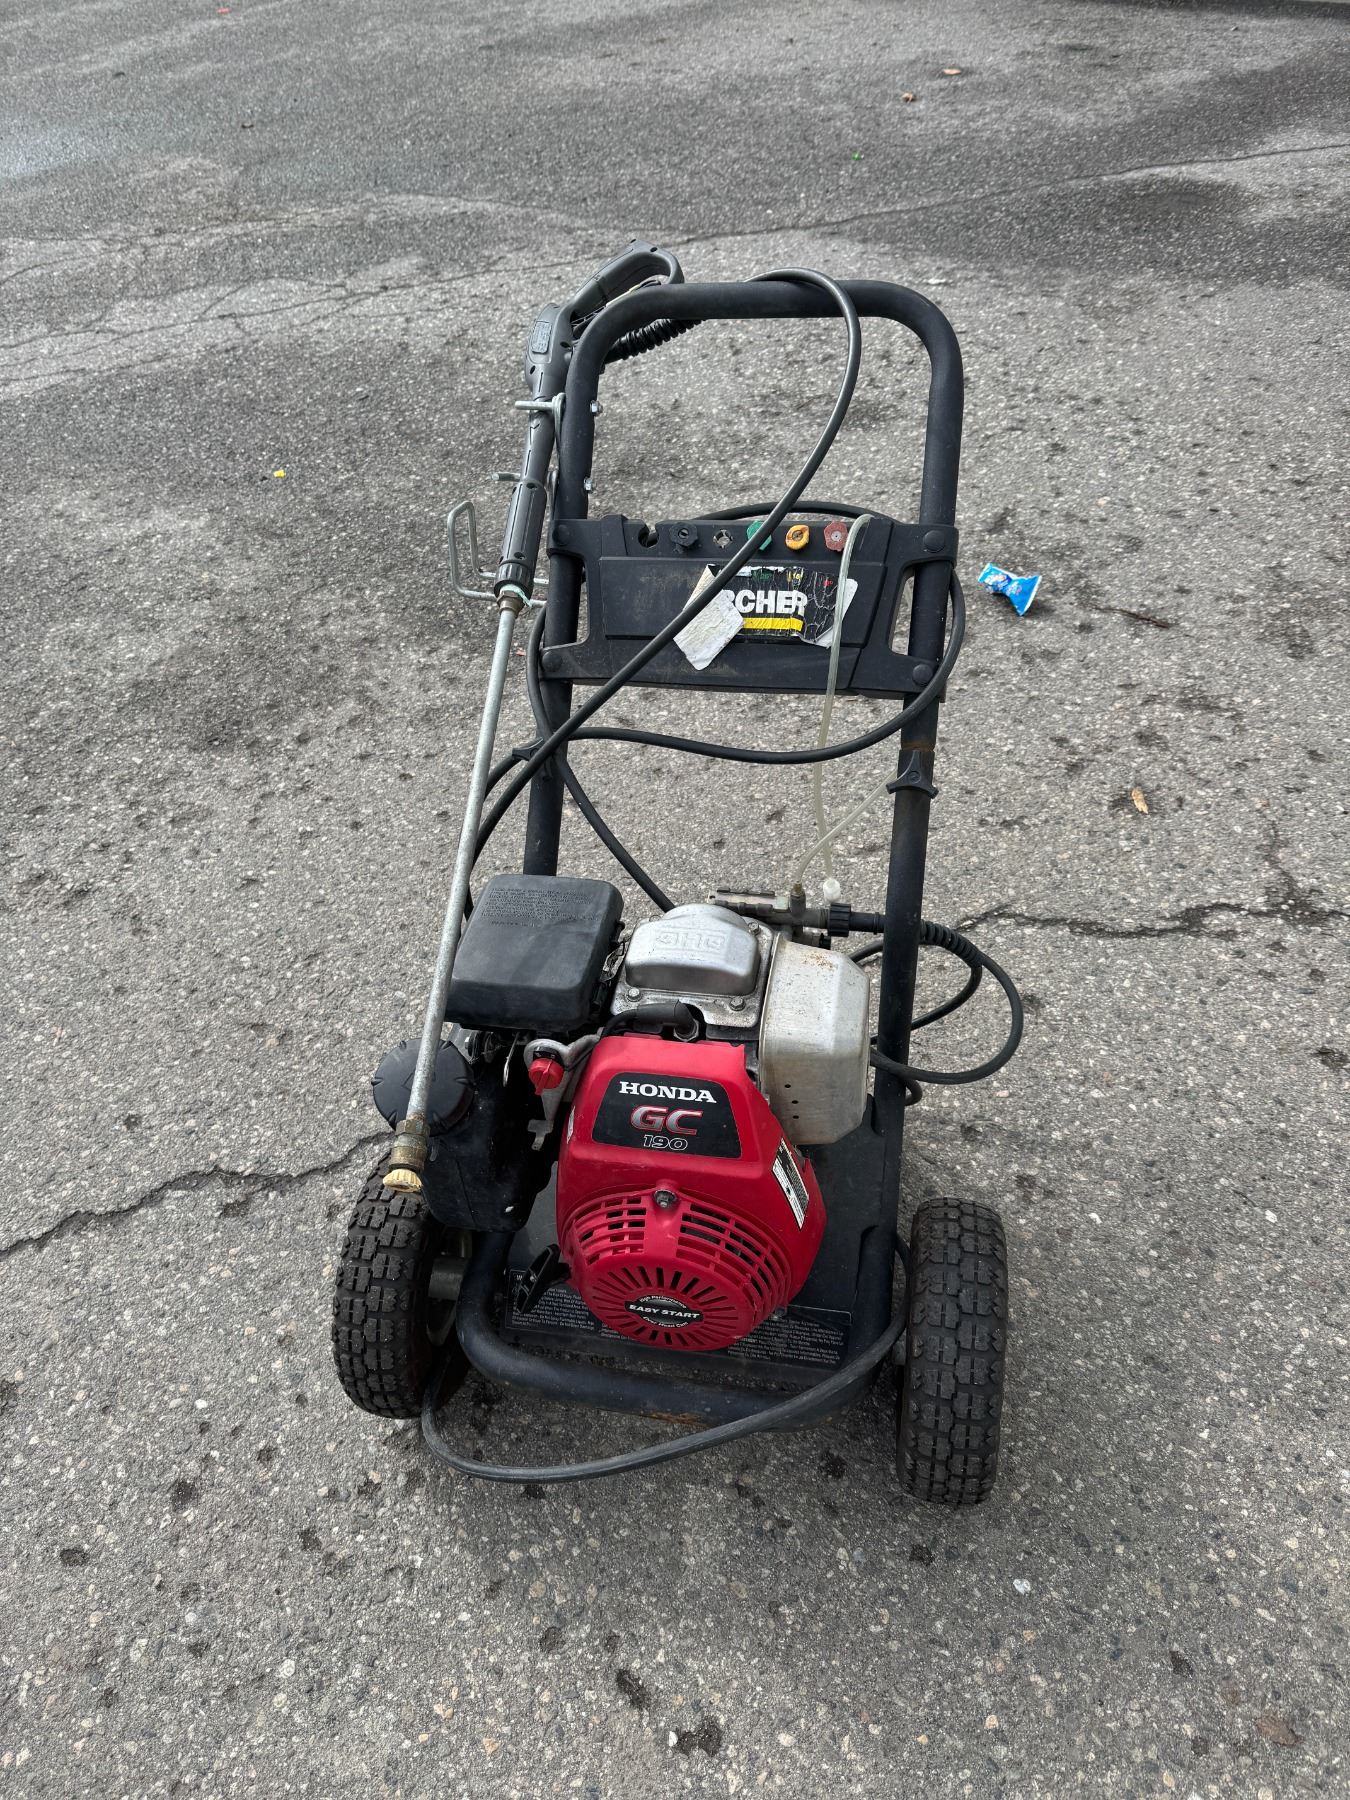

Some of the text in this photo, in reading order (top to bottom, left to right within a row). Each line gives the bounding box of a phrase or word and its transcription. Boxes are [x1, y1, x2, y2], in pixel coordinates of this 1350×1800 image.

[618, 1081, 717, 1104] HONDA
[630, 1104, 704, 1136] GC
[643, 1134, 689, 1151] 190
[629, 1304, 700, 1319] EASY START
